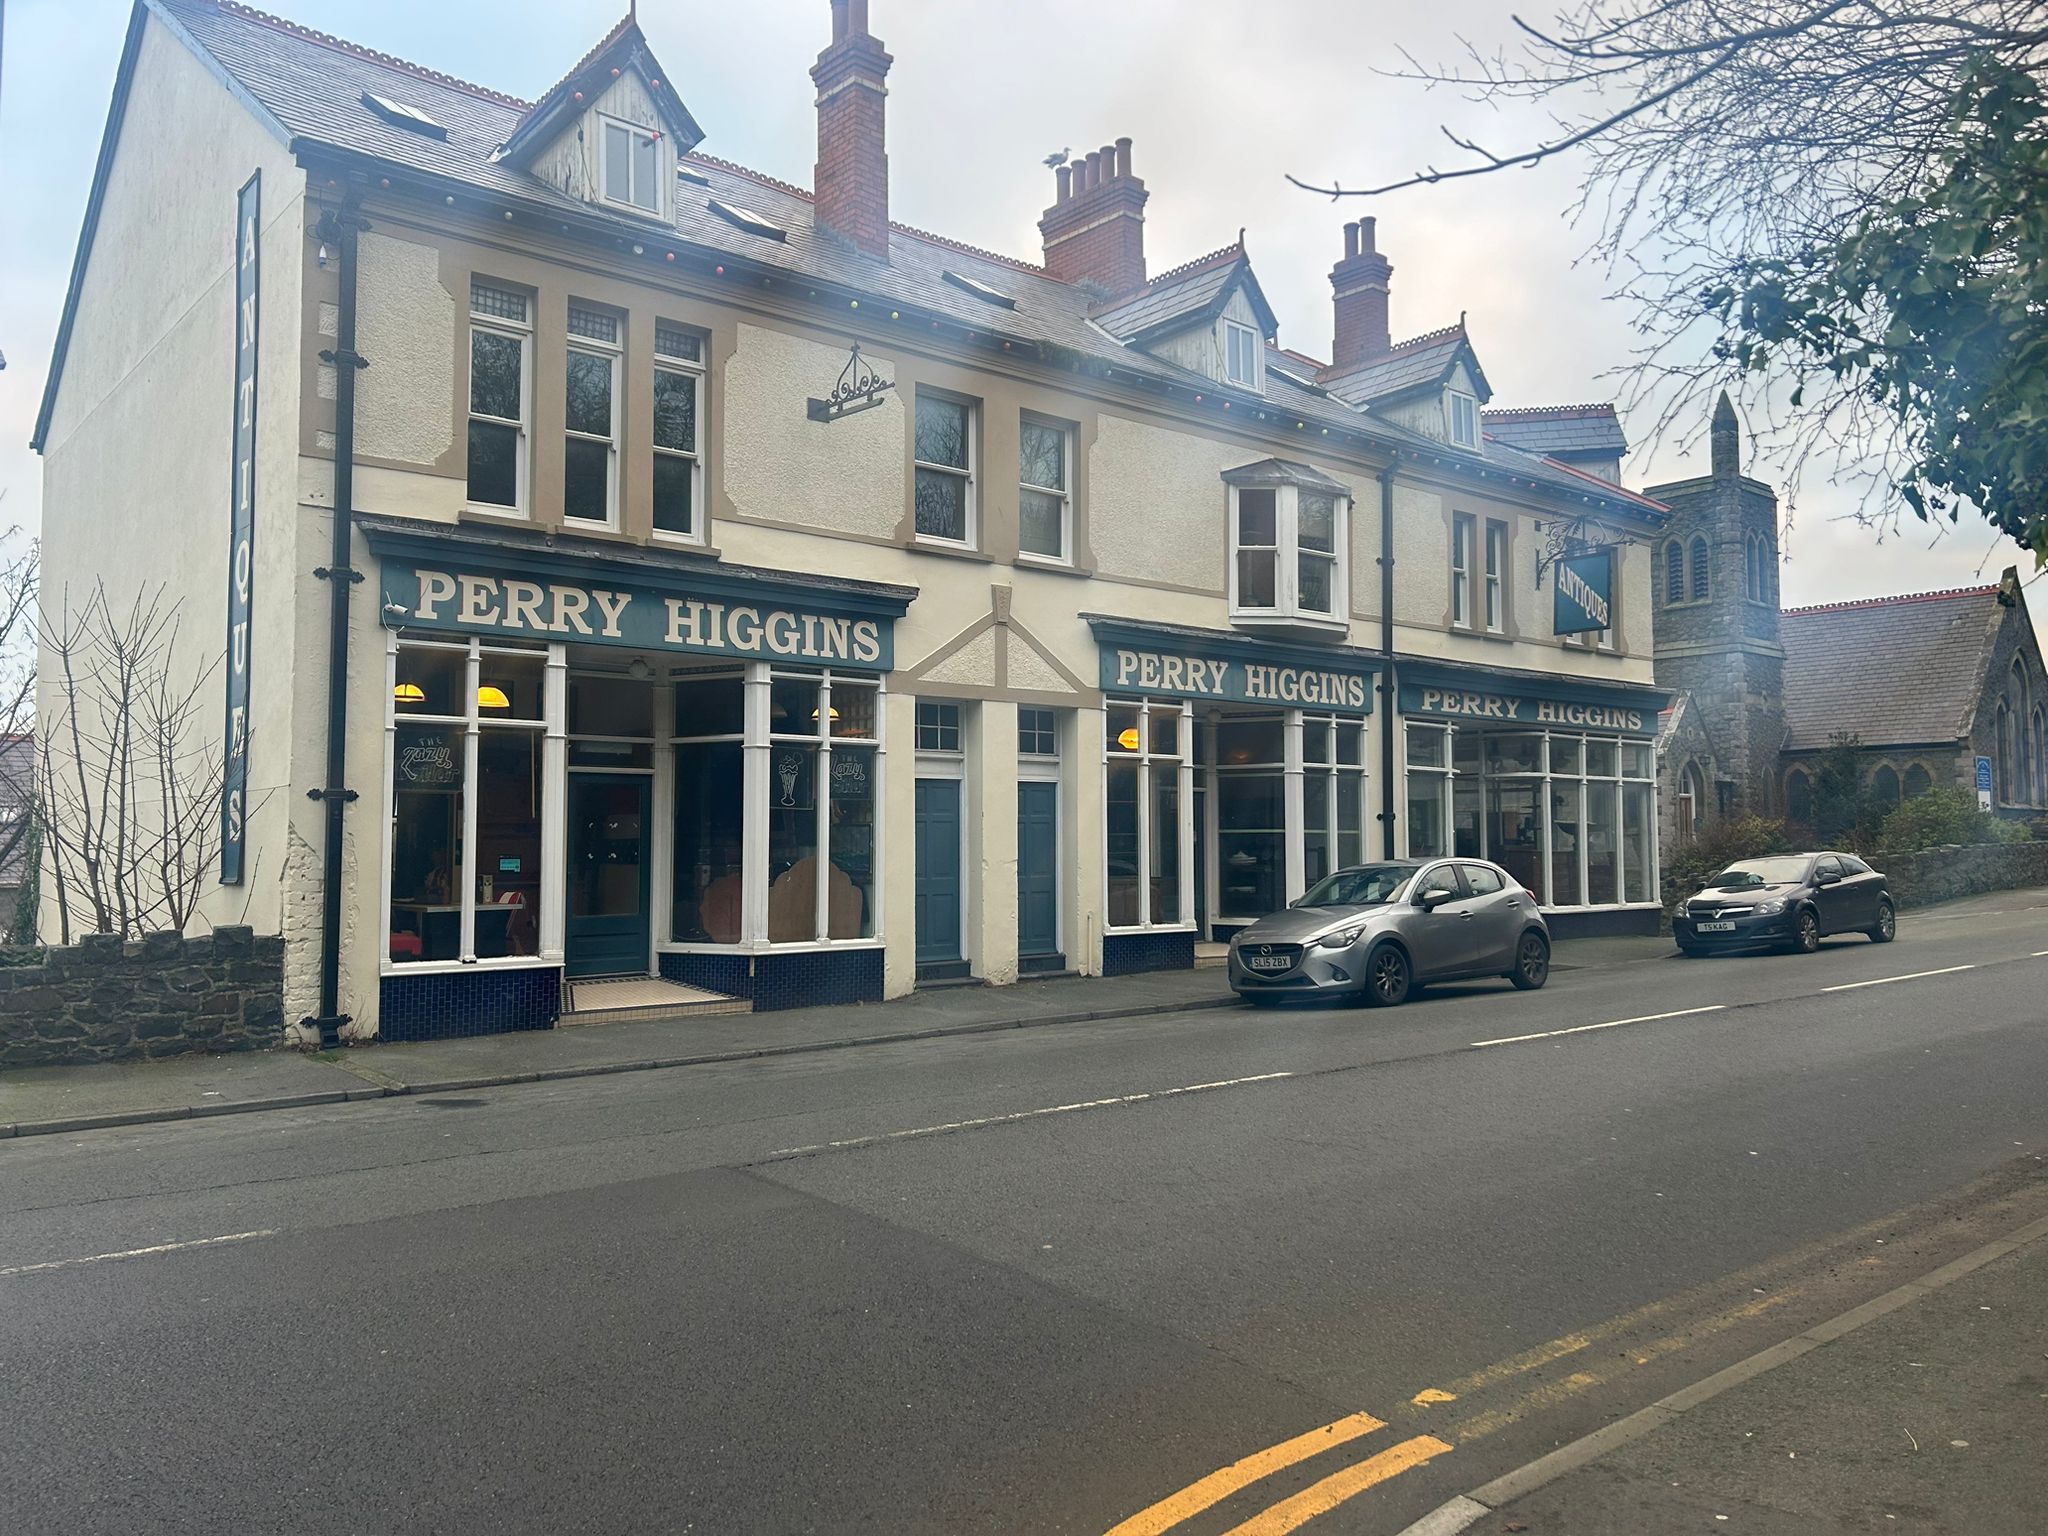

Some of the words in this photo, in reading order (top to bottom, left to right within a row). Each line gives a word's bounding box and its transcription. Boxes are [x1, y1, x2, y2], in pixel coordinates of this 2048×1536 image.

[229, 215, 256, 842] ANTIQUES
[414, 569, 632, 638] PERRY
[664, 598, 880, 663] HIGGINS
[1558, 562, 1608, 626] ANTIQUES
[1116, 650, 1229, 695] PERRY
[1244, 664, 1365, 708] HIGGINS
[1421, 688, 1521, 719] PERRY
[1536, 700, 1643, 731] HIGGINS
[1271, 957, 1288, 967] ZBX
